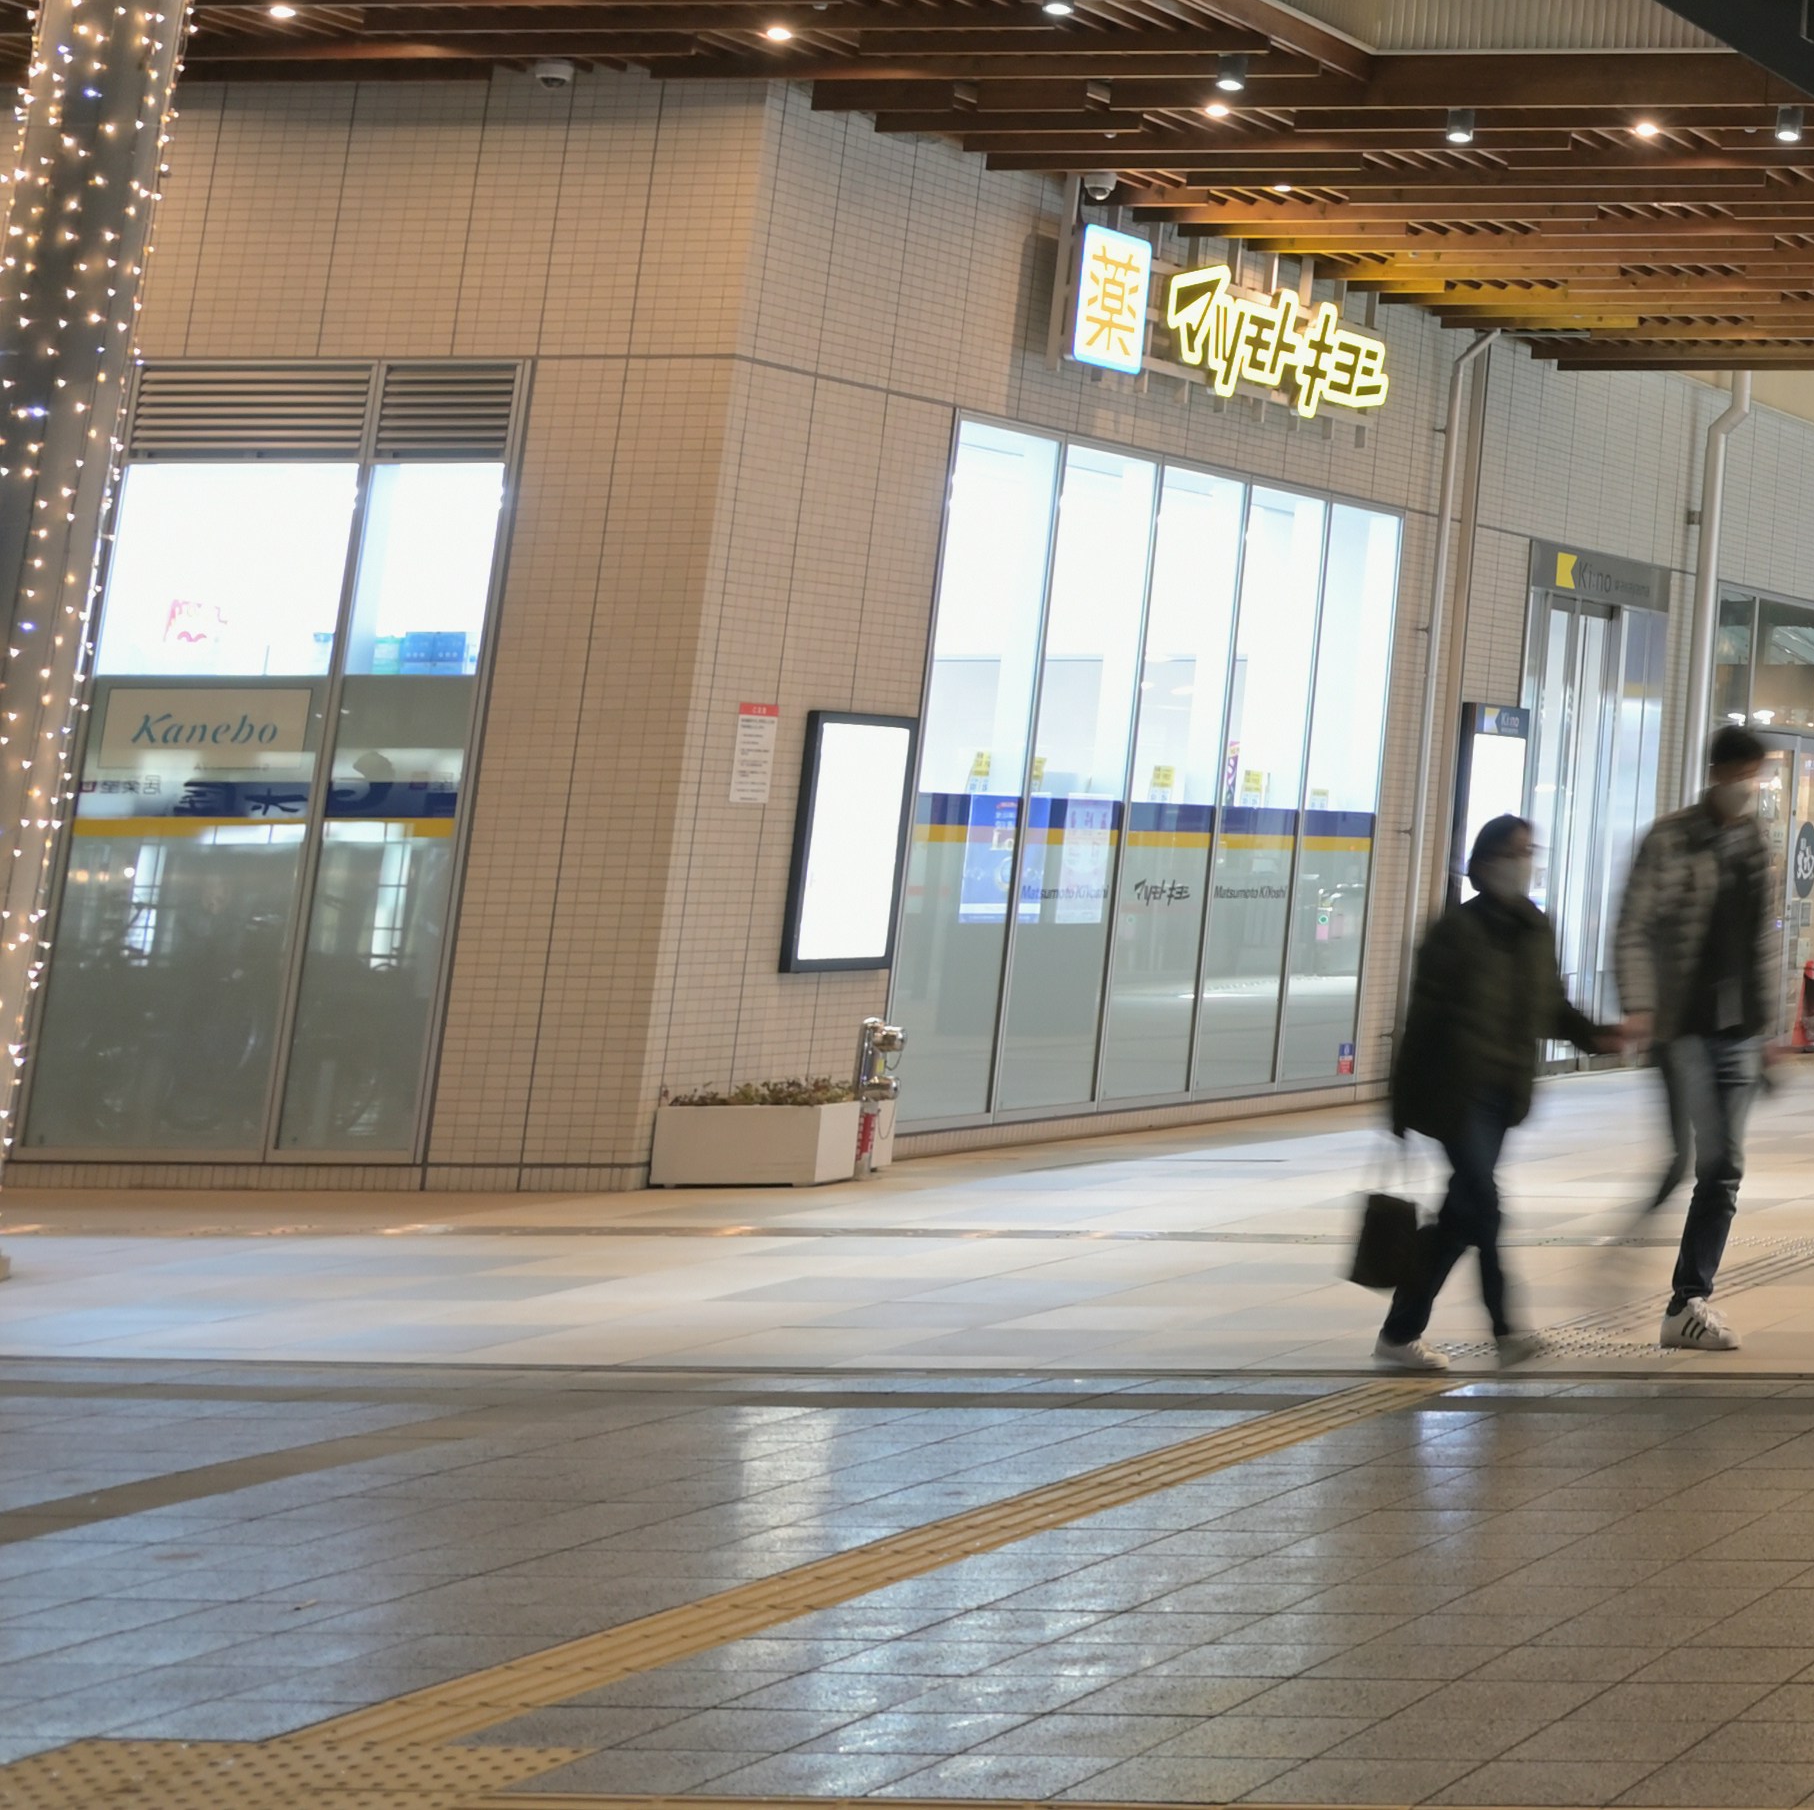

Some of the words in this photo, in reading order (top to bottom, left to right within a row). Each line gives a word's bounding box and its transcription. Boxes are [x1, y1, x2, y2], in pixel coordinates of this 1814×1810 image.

[1085, 245, 1141, 357] 薬
[1168, 265, 1389, 418] マツモトキヨシ
[131, 713, 279, 745] Kanebo
[1214, 884, 1258, 899] Matsumoto
